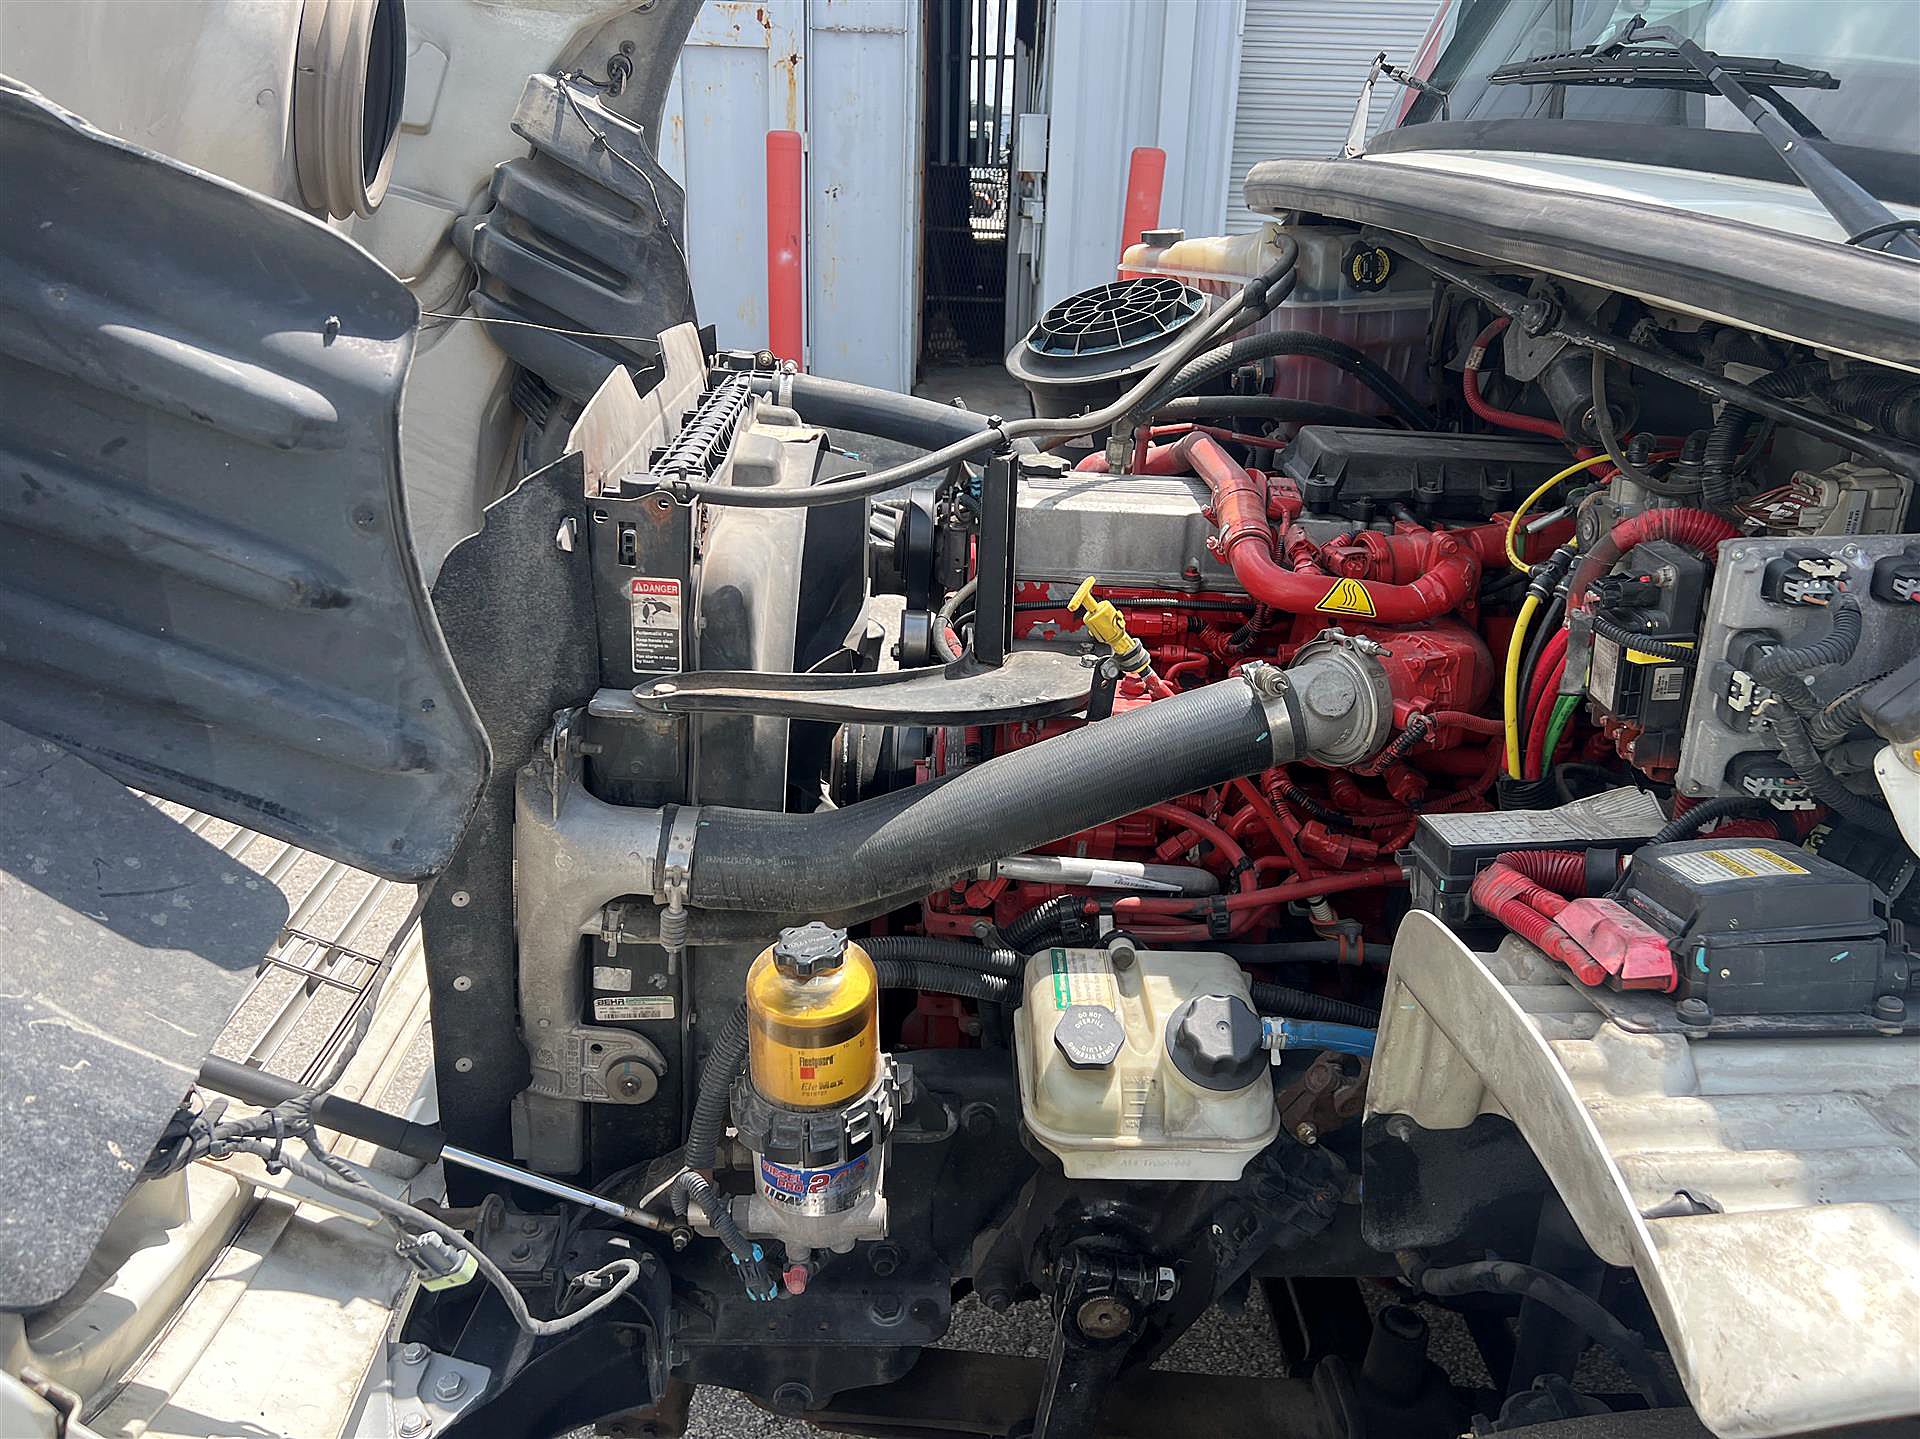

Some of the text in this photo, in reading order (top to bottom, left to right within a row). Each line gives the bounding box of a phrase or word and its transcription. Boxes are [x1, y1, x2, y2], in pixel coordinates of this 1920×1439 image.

[643, 584, 678, 594] DANGER
[596, 998, 625, 1006] BEHR
[1088, 1011, 1102, 1019] NOT
[1074, 1018, 1104, 1029] OVERFILL
[1068, 1041, 1096, 1060] STEERING
[1081, 1045, 1103, 1053] FLUID
[800, 1055, 834, 1068] Fleetguard
[762, 1160, 801, 1181] DIESEL
[776, 1178, 805, 1193] PRO
